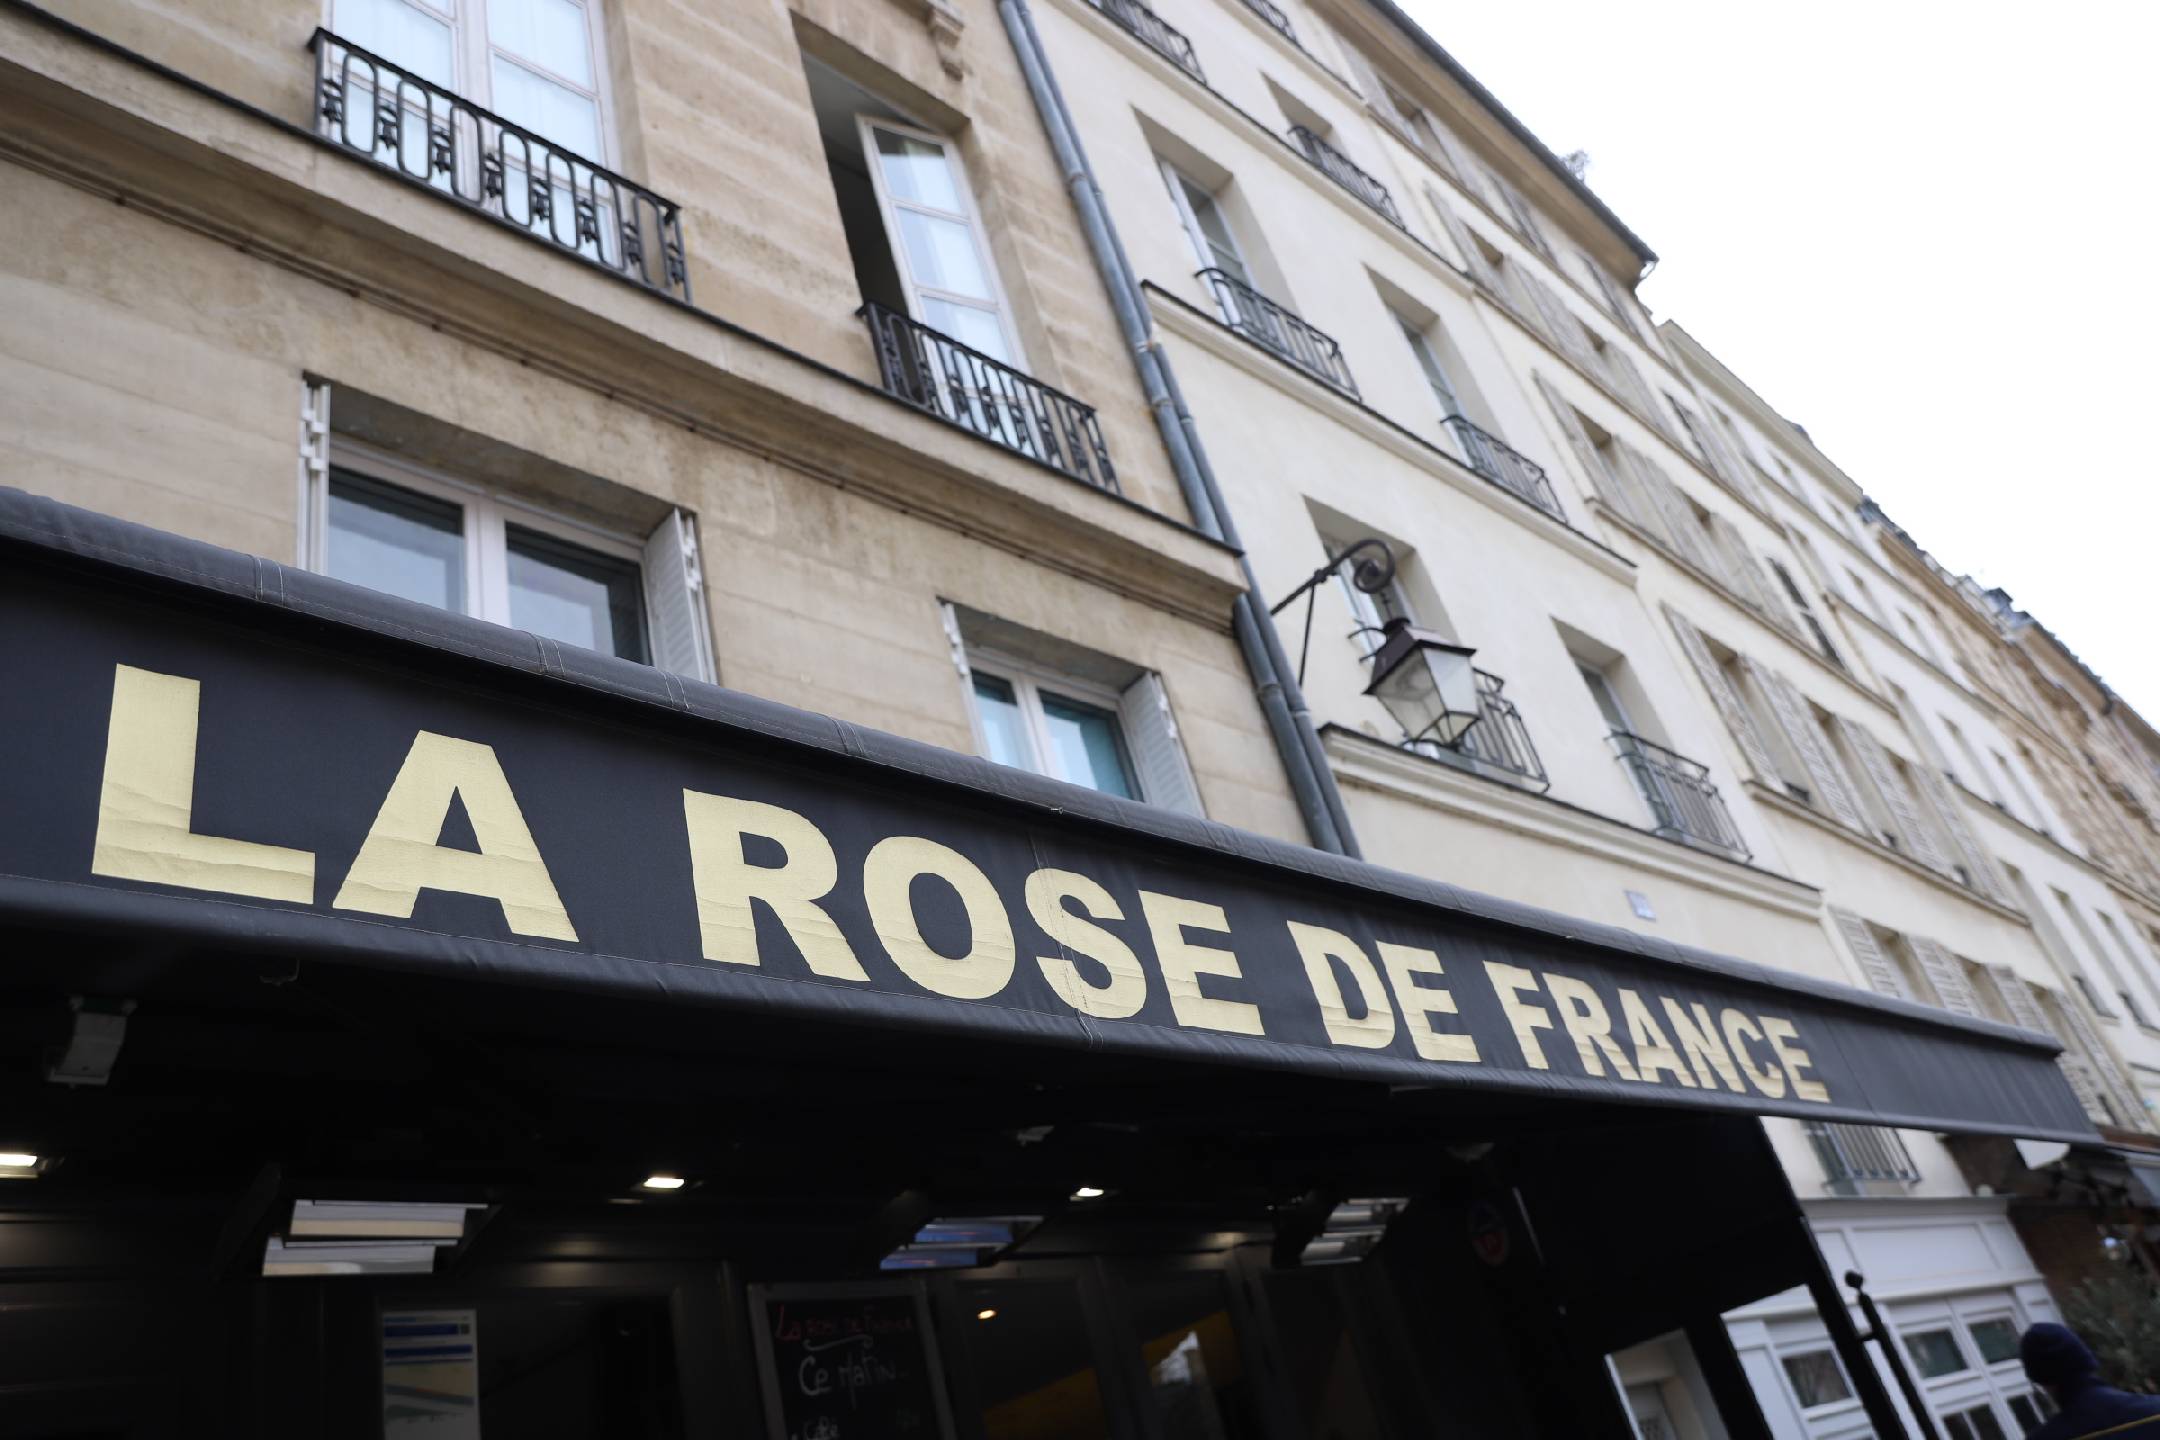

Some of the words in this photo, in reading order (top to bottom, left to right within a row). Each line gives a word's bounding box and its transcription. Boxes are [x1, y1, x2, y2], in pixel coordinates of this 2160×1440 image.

[91, 664, 580, 943] LA
[683, 788, 1266, 1036] ROSE
[1286, 919, 1482, 1063] DE
[1483, 961, 1831, 1104] FRANCE
[798, 1355, 832, 1396] Ce
